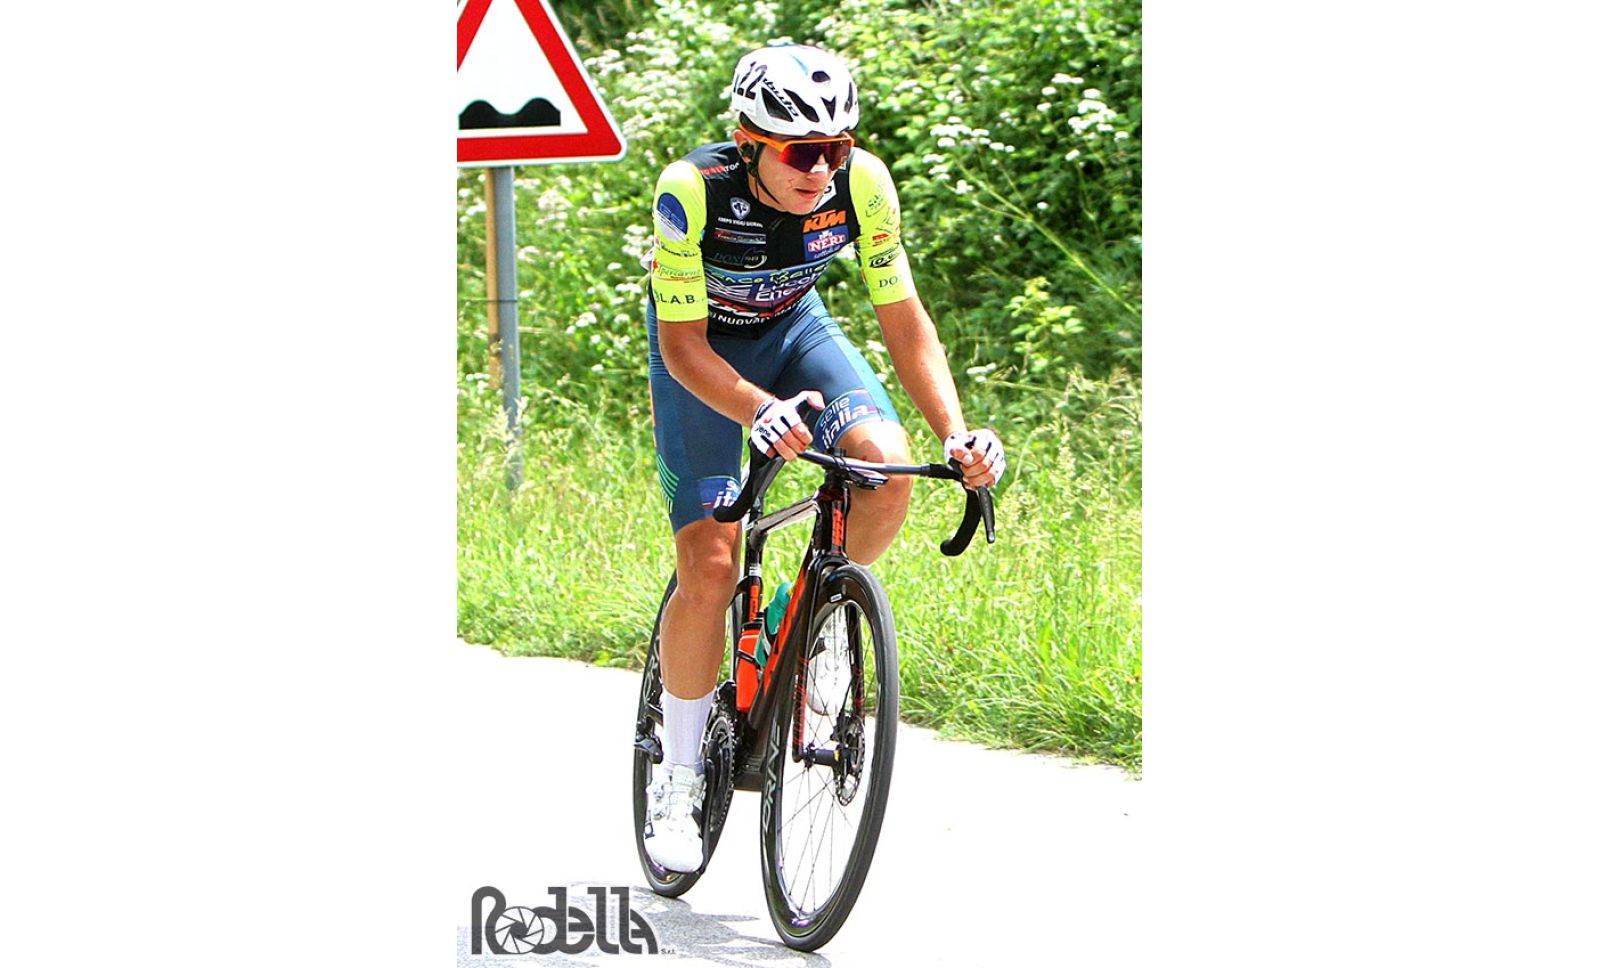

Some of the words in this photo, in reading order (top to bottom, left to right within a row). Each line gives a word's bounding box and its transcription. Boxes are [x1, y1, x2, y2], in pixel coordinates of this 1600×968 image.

[803, 209, 847, 233] KTM
[808, 234, 846, 253] NERI
[820, 396, 851, 430] selle
[822, 404, 868, 449] italia
